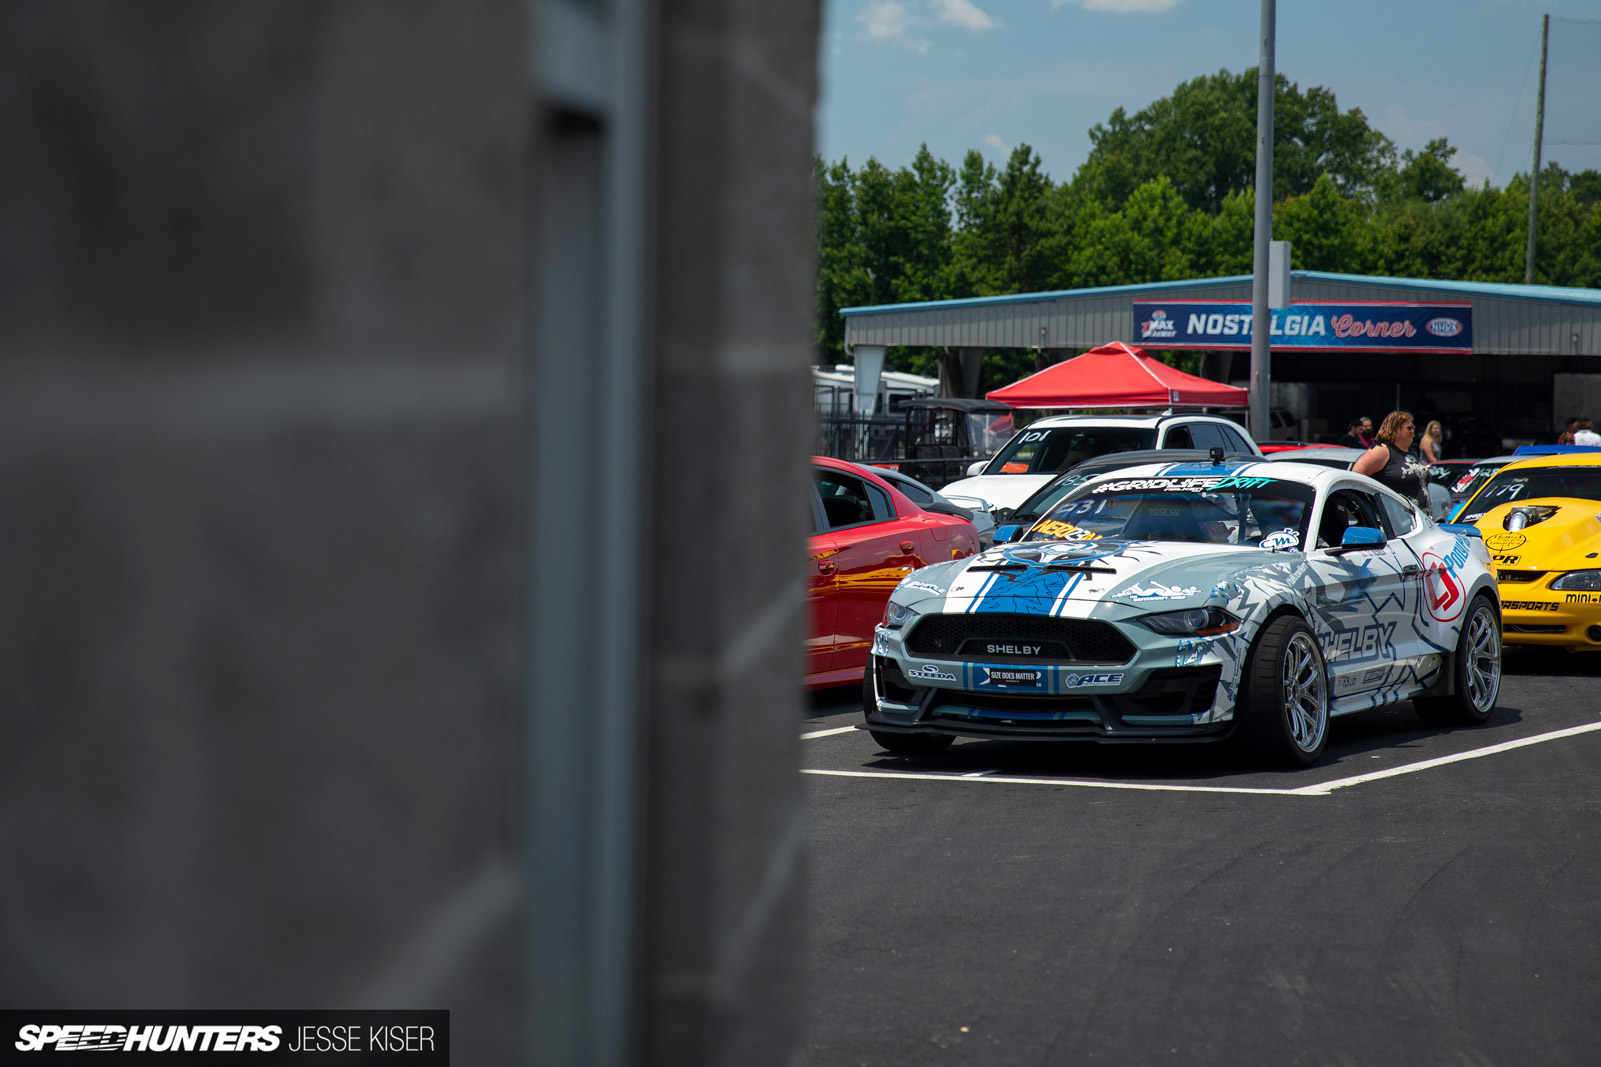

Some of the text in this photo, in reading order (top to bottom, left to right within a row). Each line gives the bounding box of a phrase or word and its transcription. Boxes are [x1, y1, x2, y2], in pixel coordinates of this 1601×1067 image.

[1186, 313, 1417, 338] NOSTLGIA Corner
[1432, 319, 1458, 334] NHRA
[1018, 430, 1052, 444] 101
[1206, 476, 1280, 491] DRIFT
[1485, 483, 1524, 499] 179
[986, 644, 1042, 655] SHELBY
[908, 669, 957, 681] STEEDA
[990, 671, 1035, 680] SIZE DOES MATTER
[1076, 673, 1124, 687] ACE
